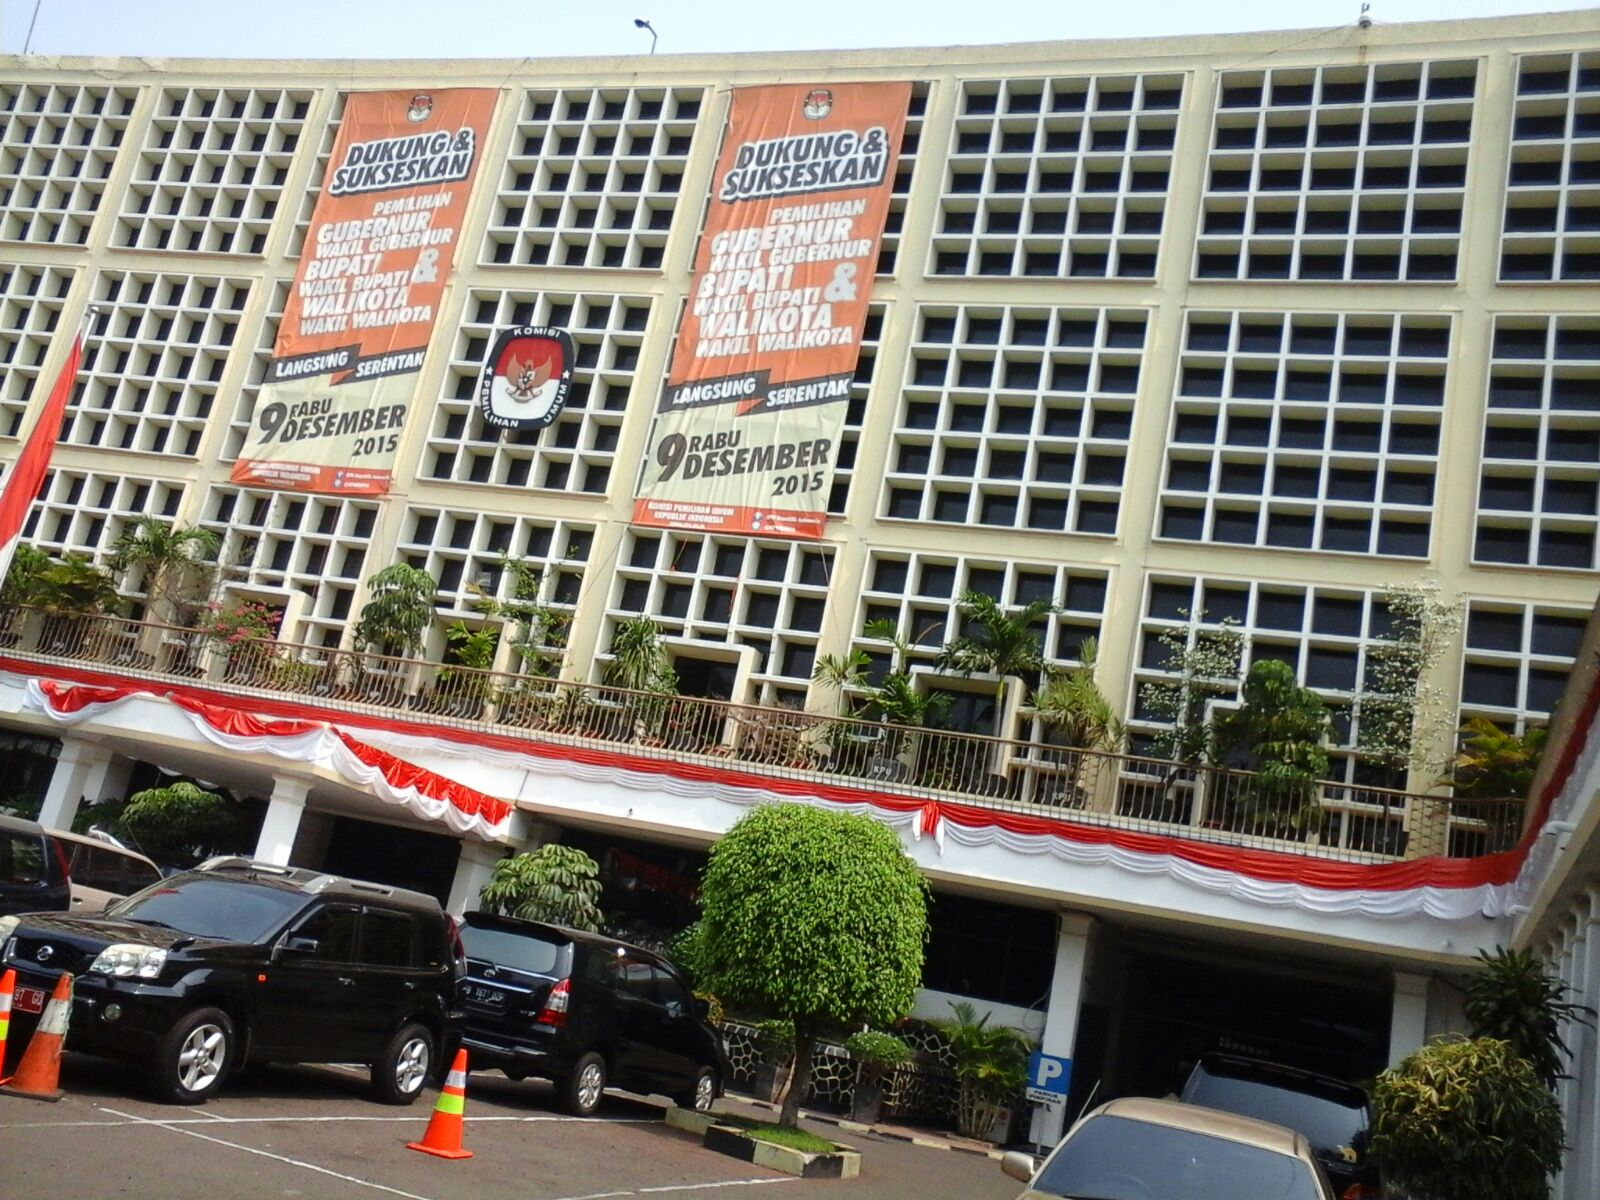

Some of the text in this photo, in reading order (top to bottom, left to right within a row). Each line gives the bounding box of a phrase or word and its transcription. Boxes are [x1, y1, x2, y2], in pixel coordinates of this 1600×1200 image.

[347, 129, 470, 167] DUKUNG &
[735, 129, 883, 169] DUKUNG &
[332, 151, 469, 190] SUKSESKAN
[723, 154, 882, 196] SUKSESKAN
[373, 192, 452, 216] PEMILIHAN
[770, 198, 867, 225] PEMILIHAN
[316, 228, 453, 259] WAKIL GUBERNUR
[317, 211, 431, 244] GUBERNUR
[711, 218, 854, 255] GUBERNUR
[304, 253, 383, 281] BUPATI
[411, 248, 439, 283] &
[710, 239, 872, 272] WAKIL GUBERNUR
[299, 271, 409, 297] WAKIL BUPATI
[698, 264, 794, 298] BUPATI
[824, 262, 857, 302] &
[302, 286, 409, 317] WALIKOTA
[693, 287, 821, 316] WAKIL BUPATI
[301, 305, 432, 336] WAKIL WALIKOTA
[513, 327, 561, 338] KOMISI
[700, 303, 832, 339] WALIKOTA
[695, 326, 853, 357] WAKIL WALIKOTA
[276, 352, 426, 378] LANGSUNG SERENTAK
[481, 380, 519, 428] PEMILIHAN
[543, 384, 568, 423] UMUM
[672, 377, 850, 407] LANGSUNG SERENTAK
[257, 401, 288, 445] 9
[279, 404, 406, 443] DESEMBER
[352, 434, 398, 457] 2015
[656, 429, 742, 482] 9 RABU
[682, 438, 832, 481] DESEMBER
[771, 471, 825, 497] 2015
[1036, 1057, 1063, 1087] P
